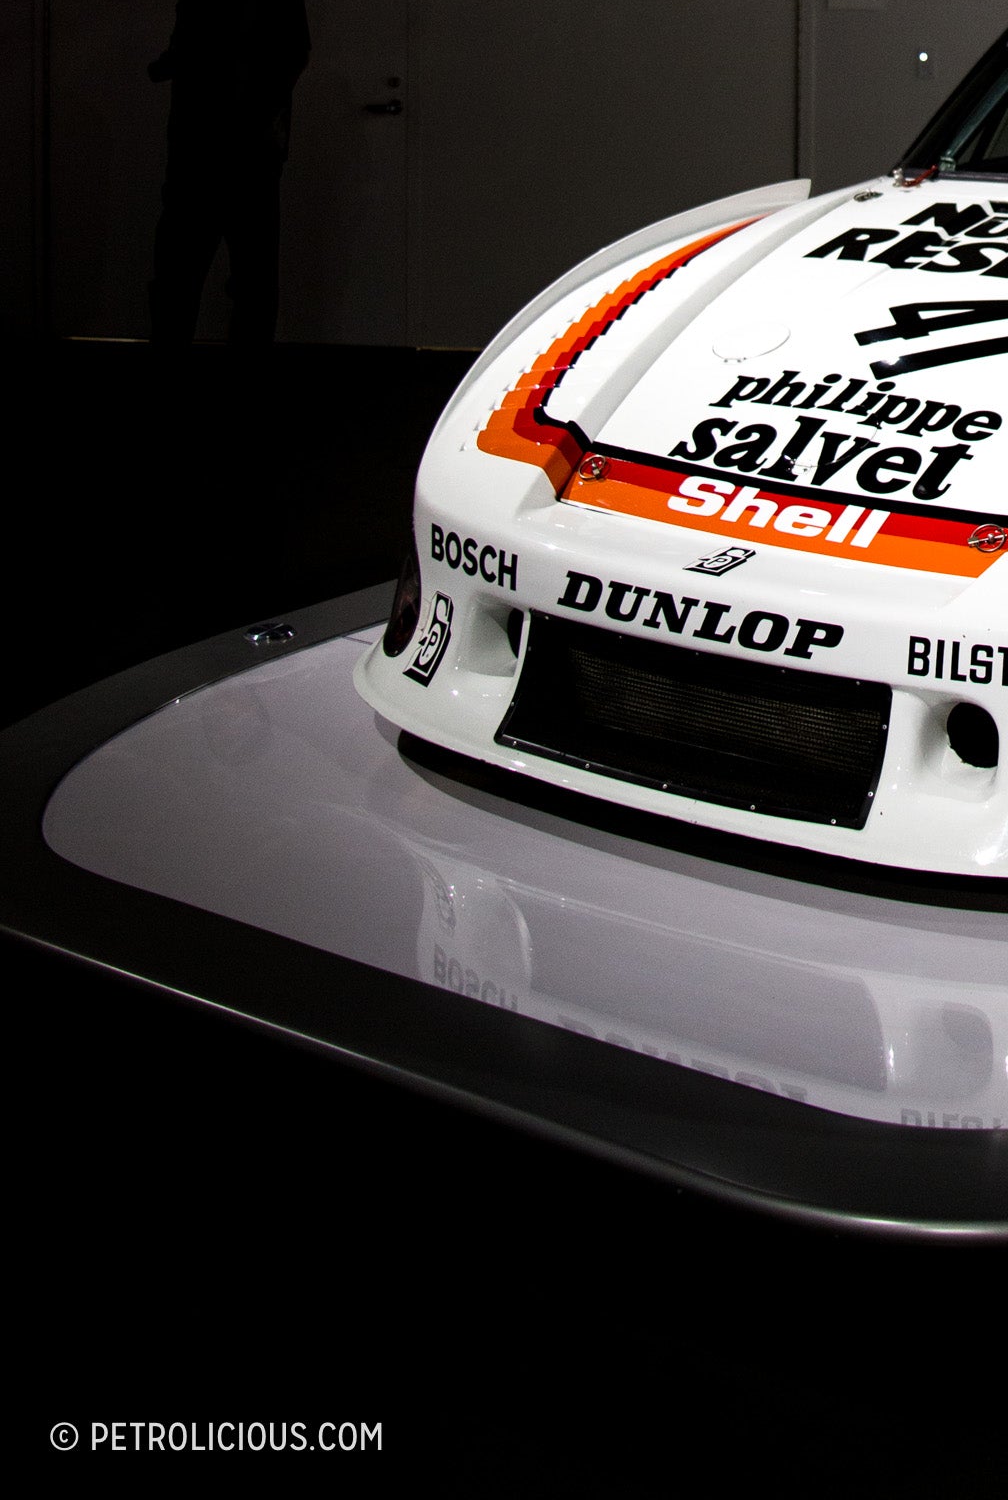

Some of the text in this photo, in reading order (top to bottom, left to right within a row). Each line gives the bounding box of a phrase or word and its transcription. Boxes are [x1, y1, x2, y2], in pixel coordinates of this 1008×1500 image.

[709, 369, 1003, 442] philippe
[667, 415, 975, 501] salvet
[667, 474, 892, 550] Shell
[431, 522, 519, 592] BOSCH
[557, 570, 845, 661] DUNLOP
